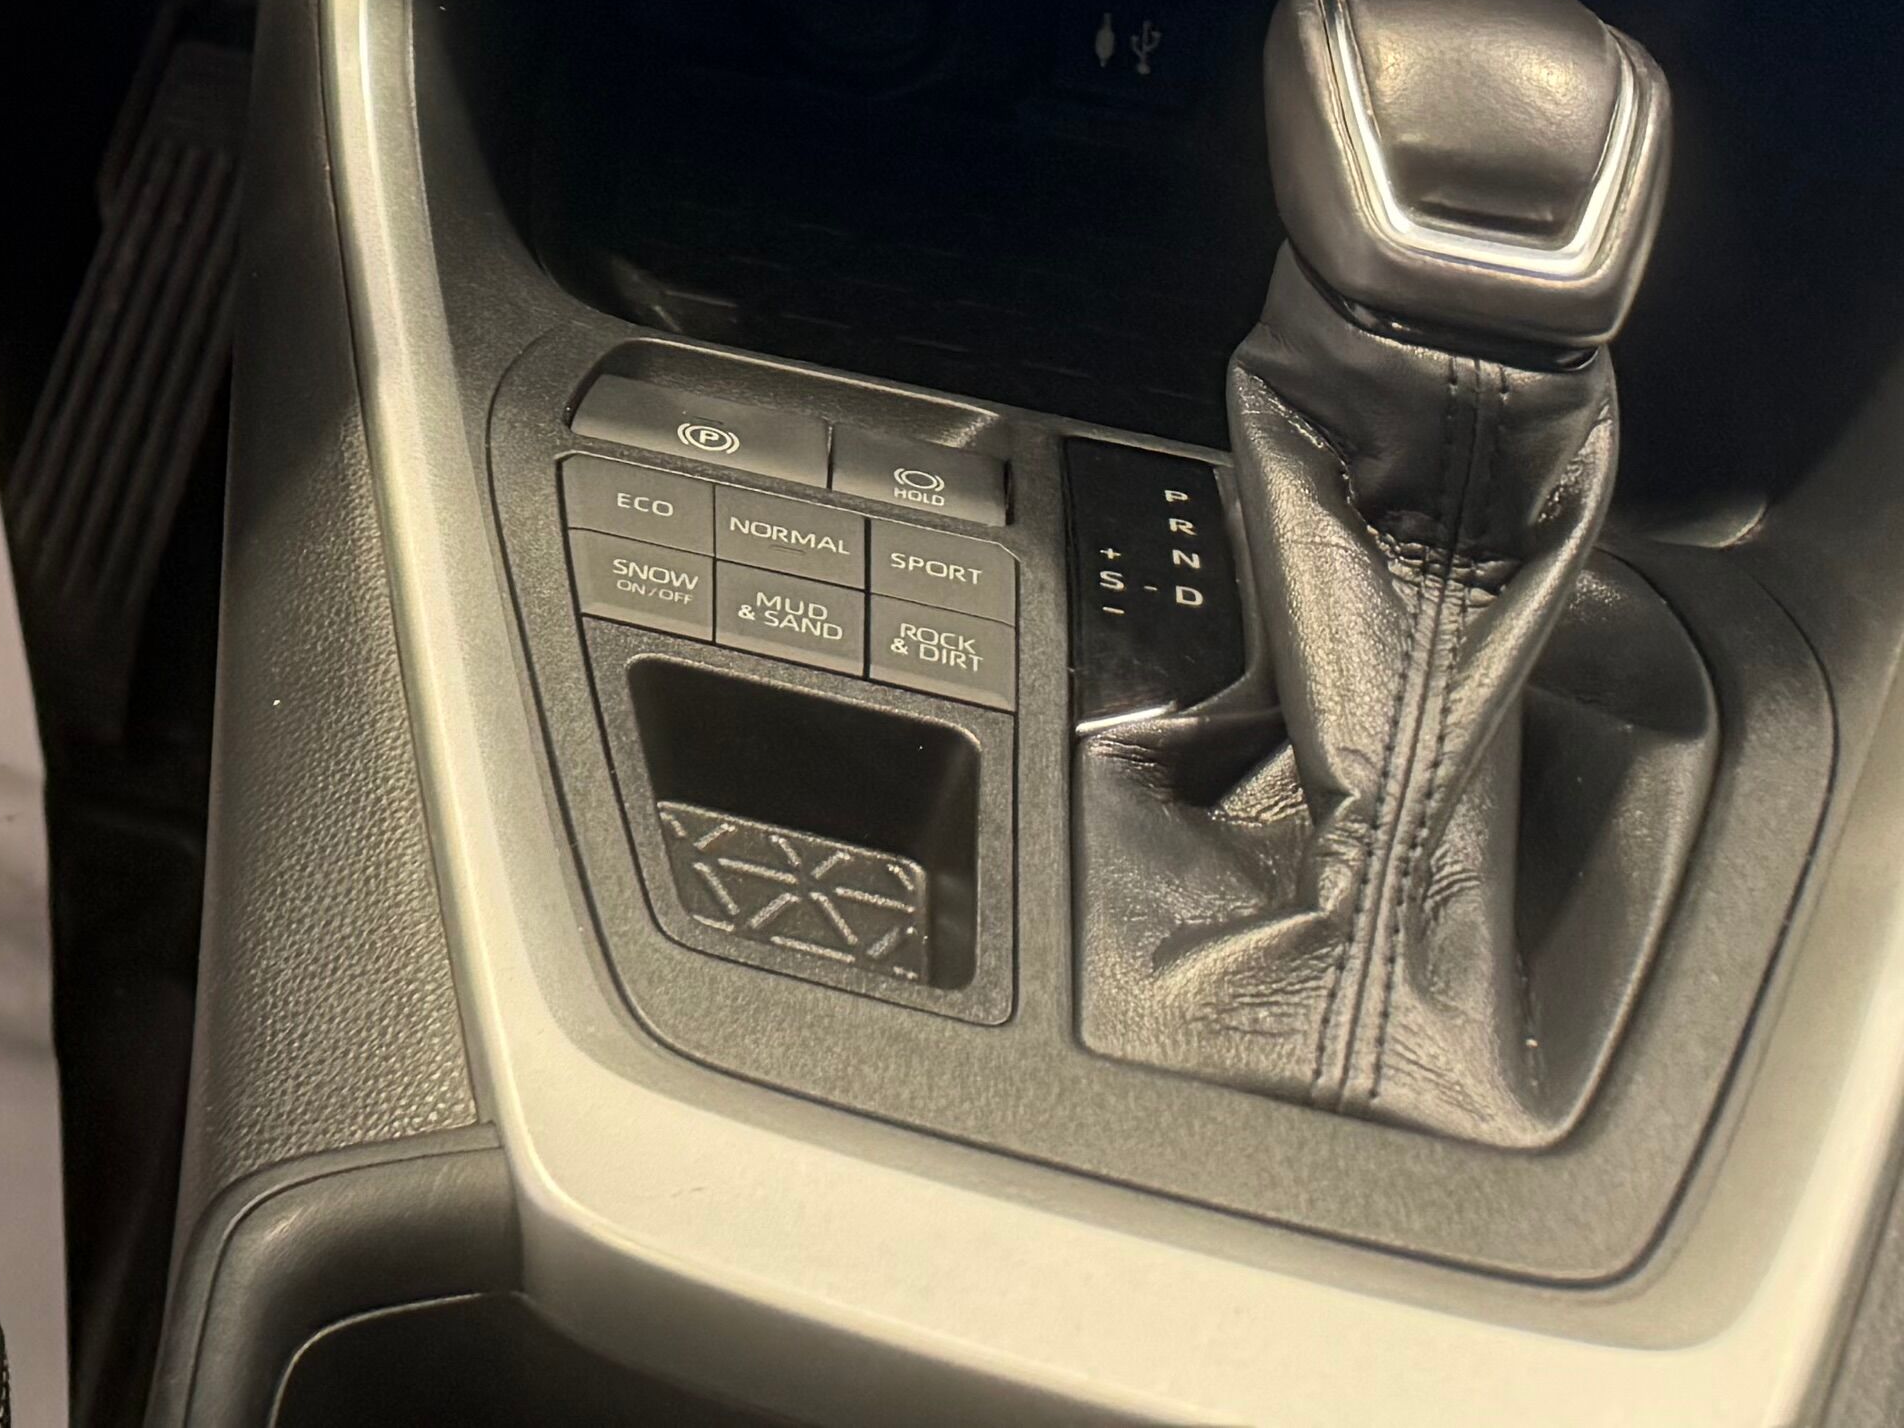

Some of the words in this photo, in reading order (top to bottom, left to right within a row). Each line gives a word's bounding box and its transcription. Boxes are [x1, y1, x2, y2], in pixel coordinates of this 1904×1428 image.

[615, 491, 675, 519] ECO
[893, 487, 946, 507] HOLD
[1164, 489, 1189, 504] P
[729, 515, 851, 556] NORMAL
[1169, 517, 1197, 536] R
[611, 557, 699, 589] SNOW
[889, 551, 984, 586] SPORT
[1171, 549, 1201, 569] N
[755, 590, 829, 621] MUD
[1174, 585, 1205, 607] D
[762, 609, 844, 641] SAND
[898, 622, 978, 654] ROCK
[918, 643, 984, 674] DIRT
